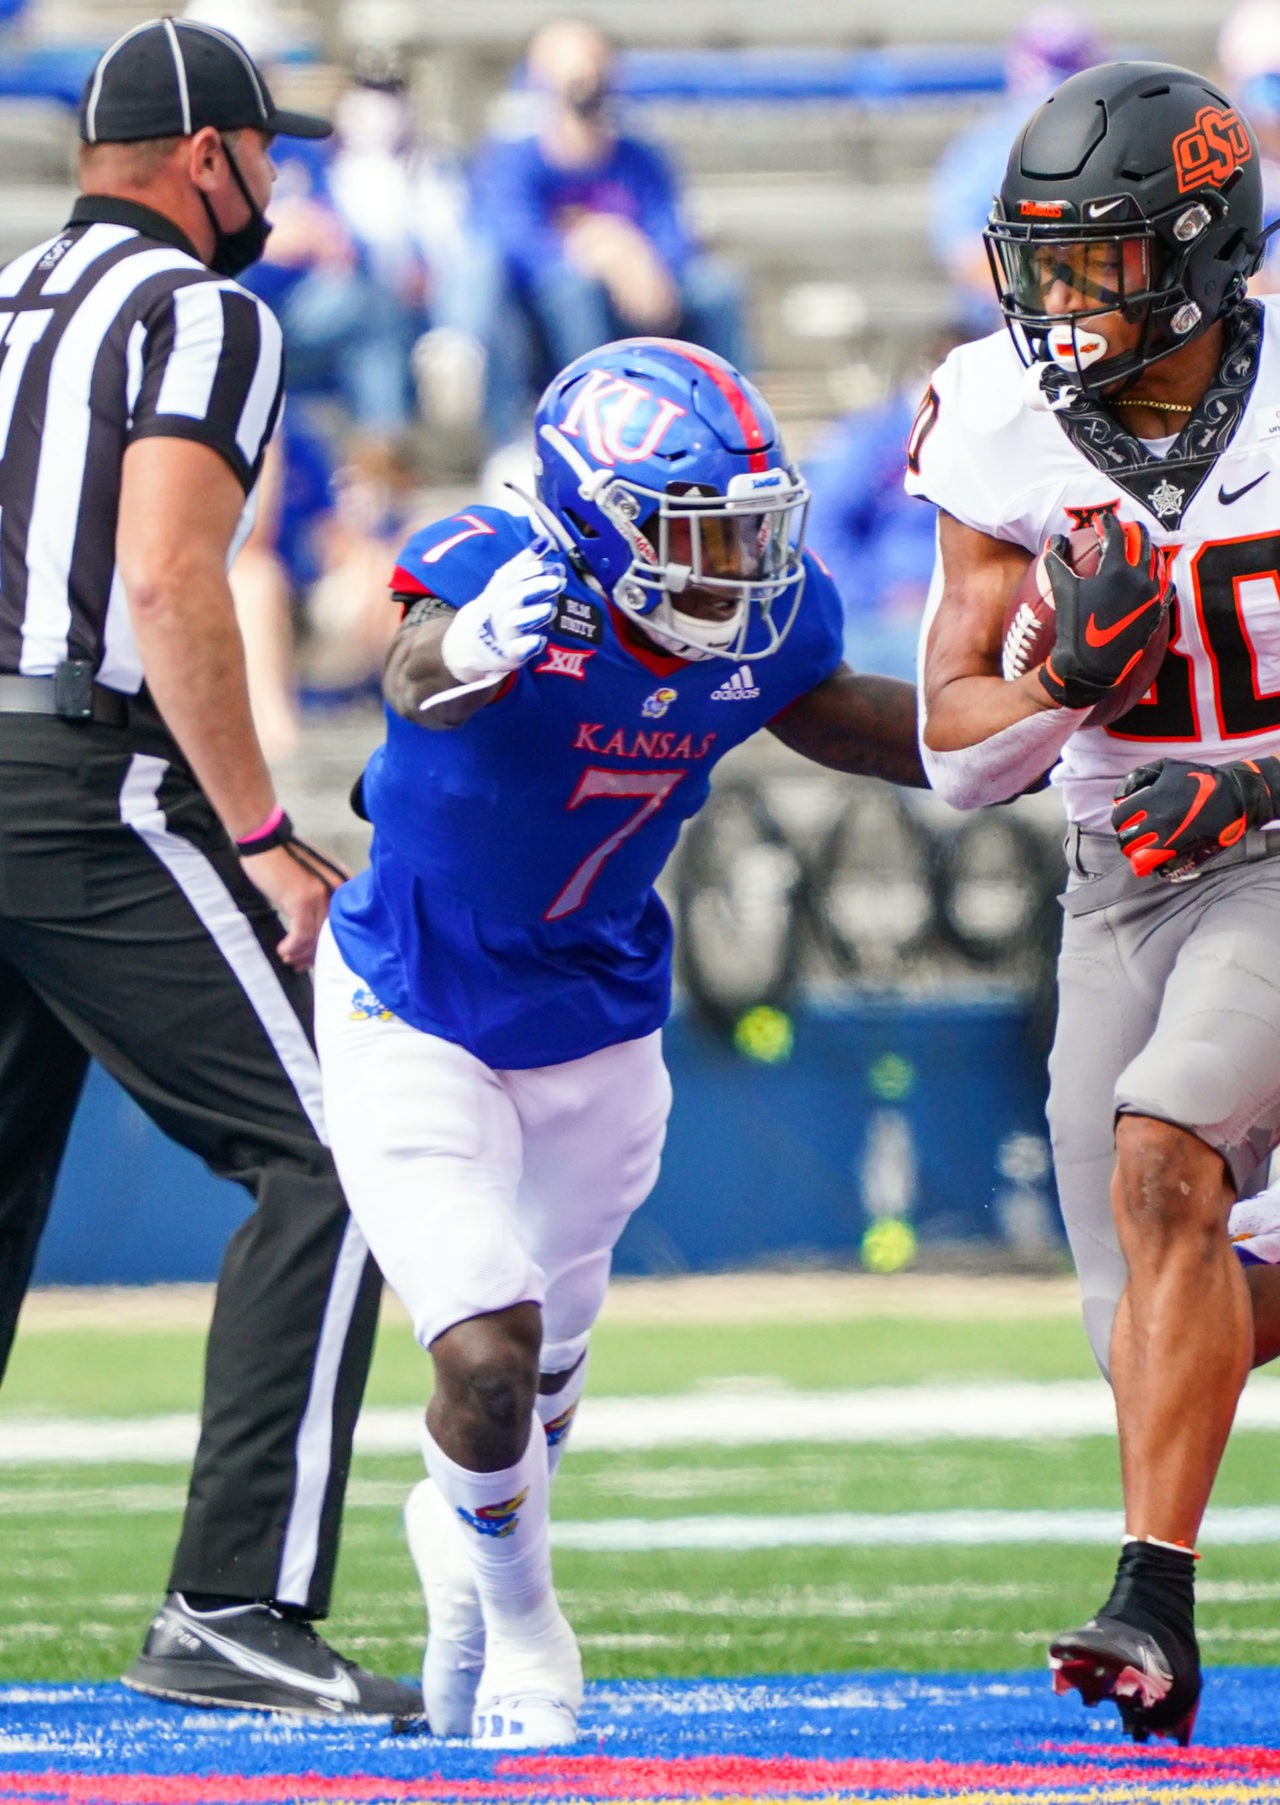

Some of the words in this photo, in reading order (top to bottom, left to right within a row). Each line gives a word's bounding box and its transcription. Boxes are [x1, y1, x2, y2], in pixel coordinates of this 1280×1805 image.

[1172, 105, 1253, 194] OSU
[558, 368, 687, 467] KU
[421, 513, 497, 564] 7
[710, 687, 761, 701] adidas
[573, 722, 717, 760] KANSAS
[543, 765, 687, 922] 7
